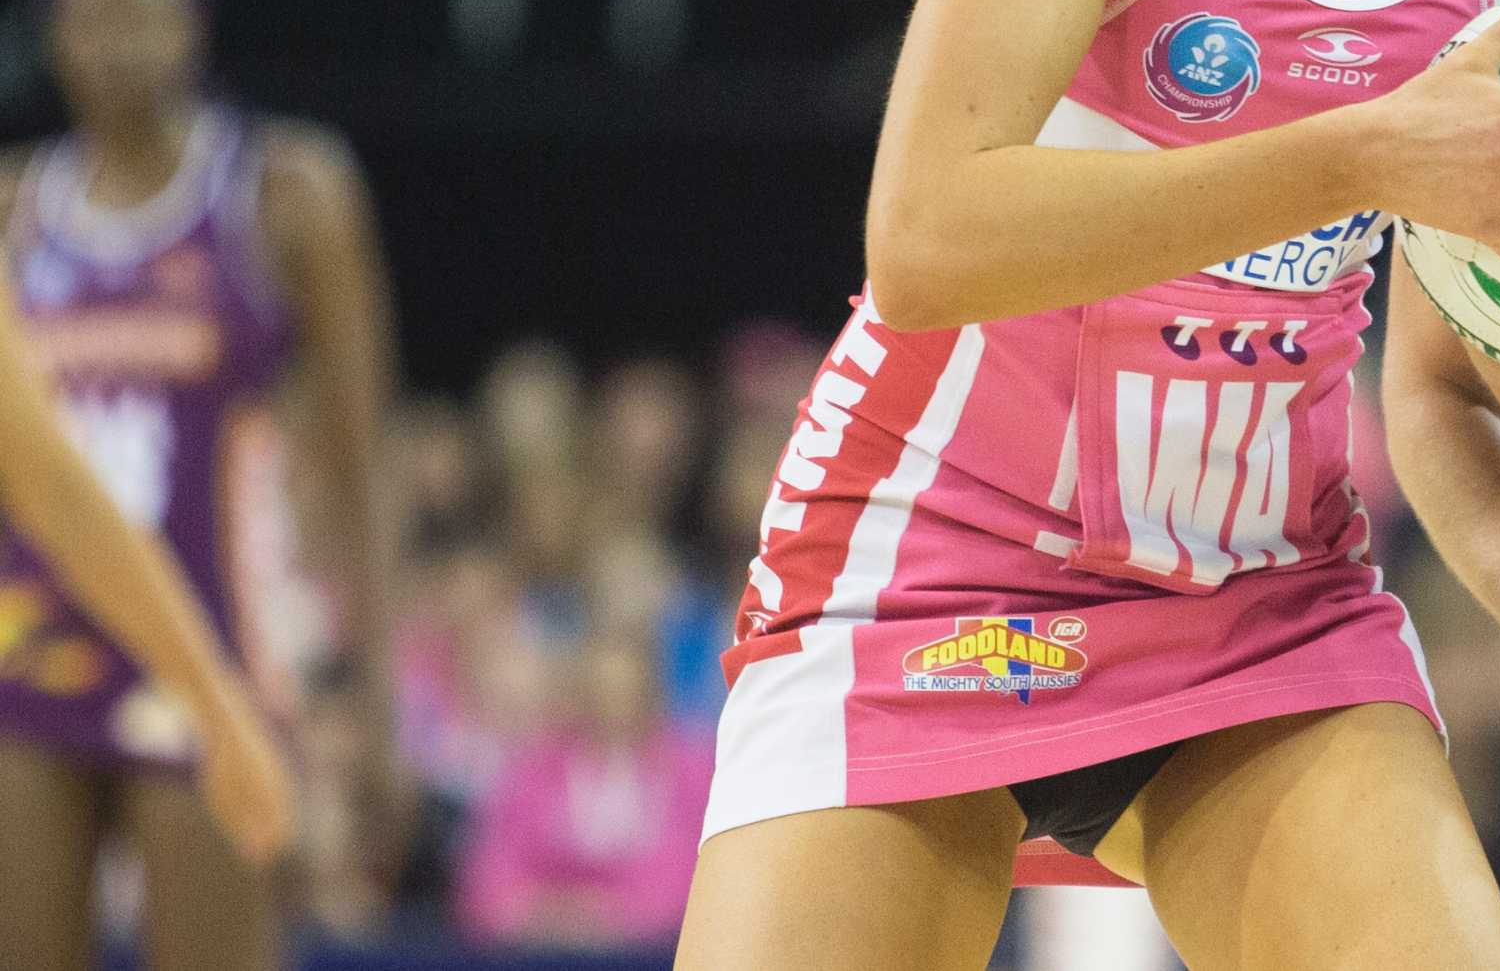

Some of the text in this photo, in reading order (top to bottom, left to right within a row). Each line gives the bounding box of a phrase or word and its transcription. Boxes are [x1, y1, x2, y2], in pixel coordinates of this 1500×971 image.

[1178, 63, 1225, 87] ANZ
[1287, 62, 1379, 87] SCODY
[1157, 73, 1233, 109] CHAMPIONSHIP
[1224, 240, 1358, 286] ERGY
[1116, 370, 1306, 587] WA
[1054, 622, 1082, 637] IGA
[922, 626, 1066, 671] FOODLAND
[905, 673, 1081, 690] THE MIGHTY SOUTH AUSSIES
